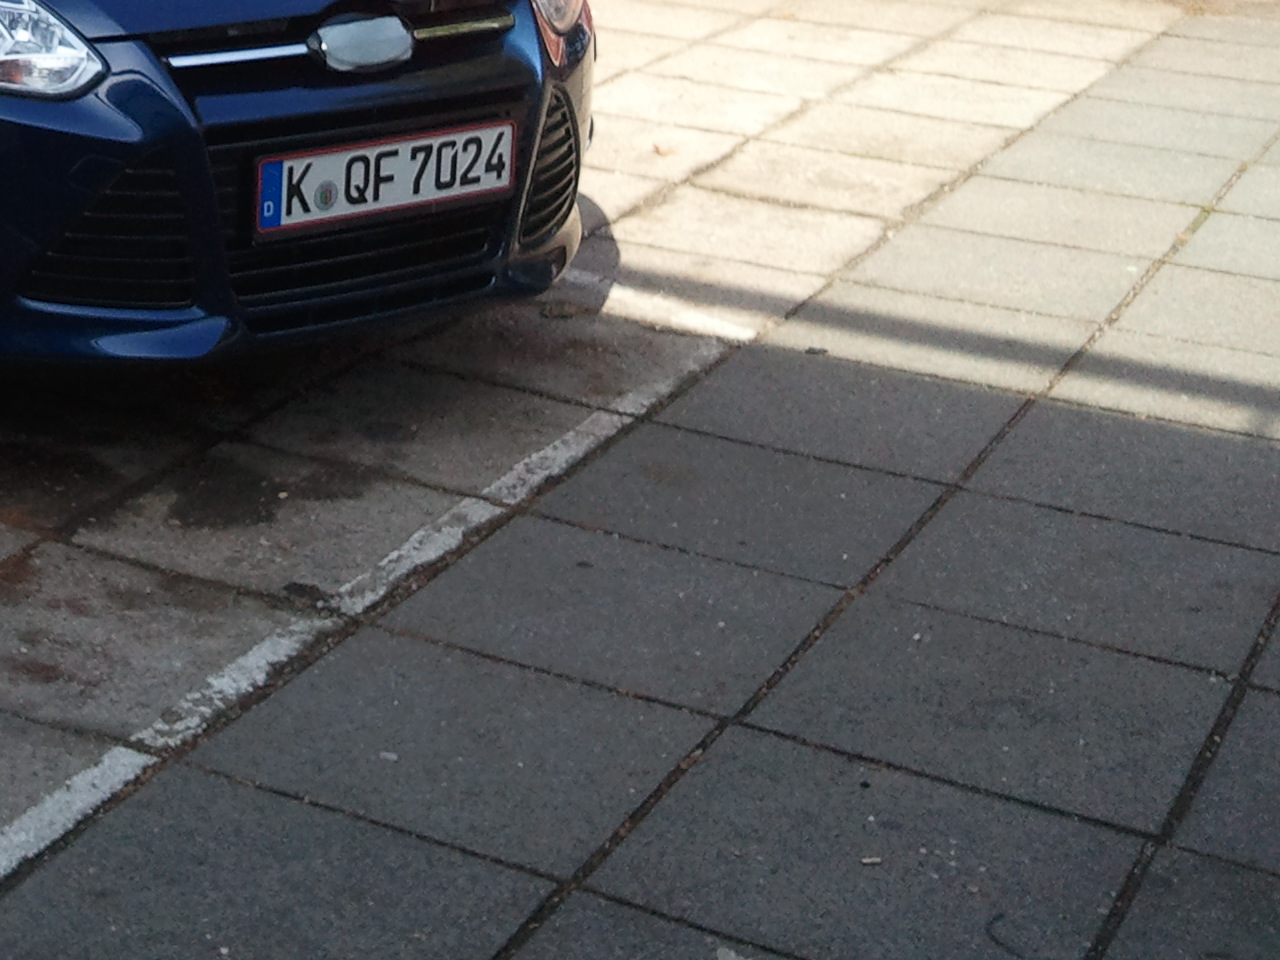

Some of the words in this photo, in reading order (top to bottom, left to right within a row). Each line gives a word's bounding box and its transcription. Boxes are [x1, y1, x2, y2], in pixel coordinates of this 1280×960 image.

[263, 201, 274, 217] D
[285, 161, 314, 216] K
[343, 149, 400, 205] QF
[409, 131, 506, 195] 7024
